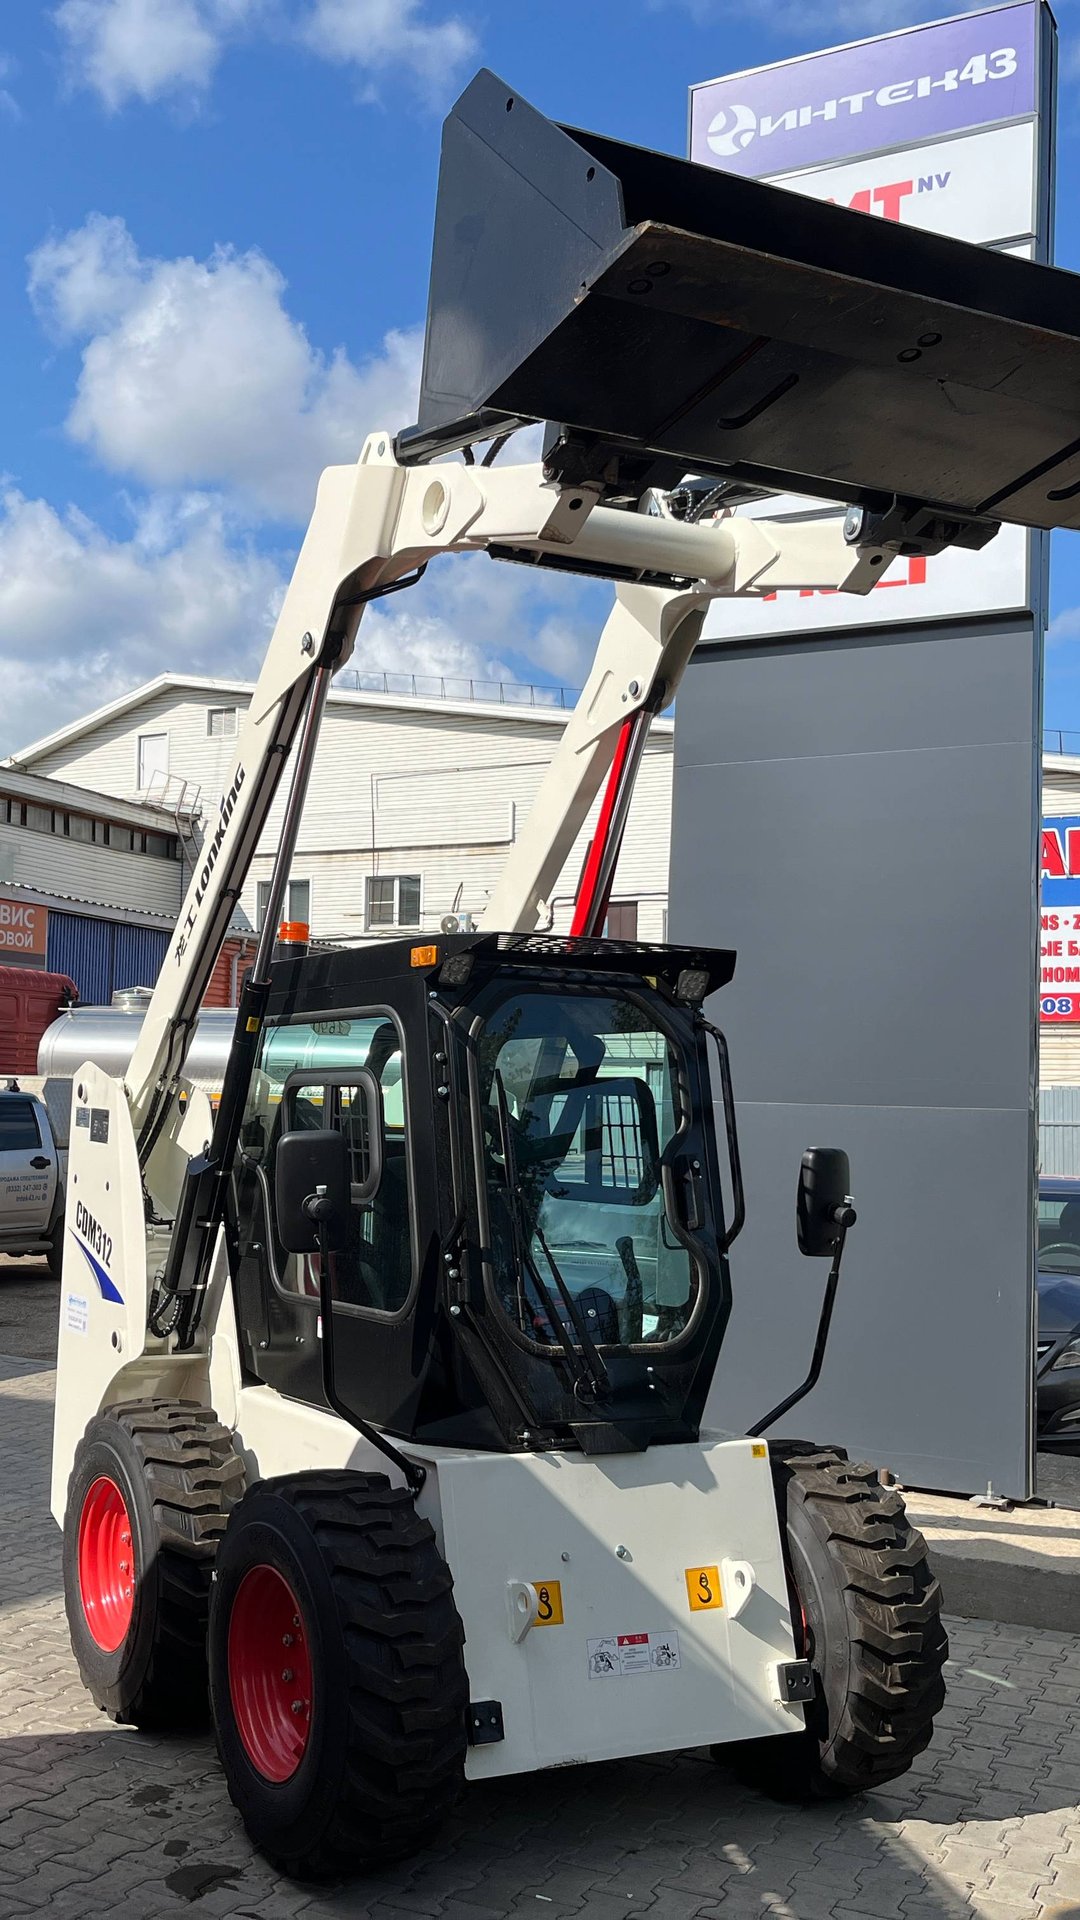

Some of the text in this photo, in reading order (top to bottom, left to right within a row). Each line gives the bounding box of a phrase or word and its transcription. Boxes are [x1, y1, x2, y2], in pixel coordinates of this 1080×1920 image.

[918, 171, 951, 193] NV
[1068, 941, 1080, 956] Б
[1040, 967, 1080, 982] НОМ
[76, 1200, 112, 1268] CDM312
